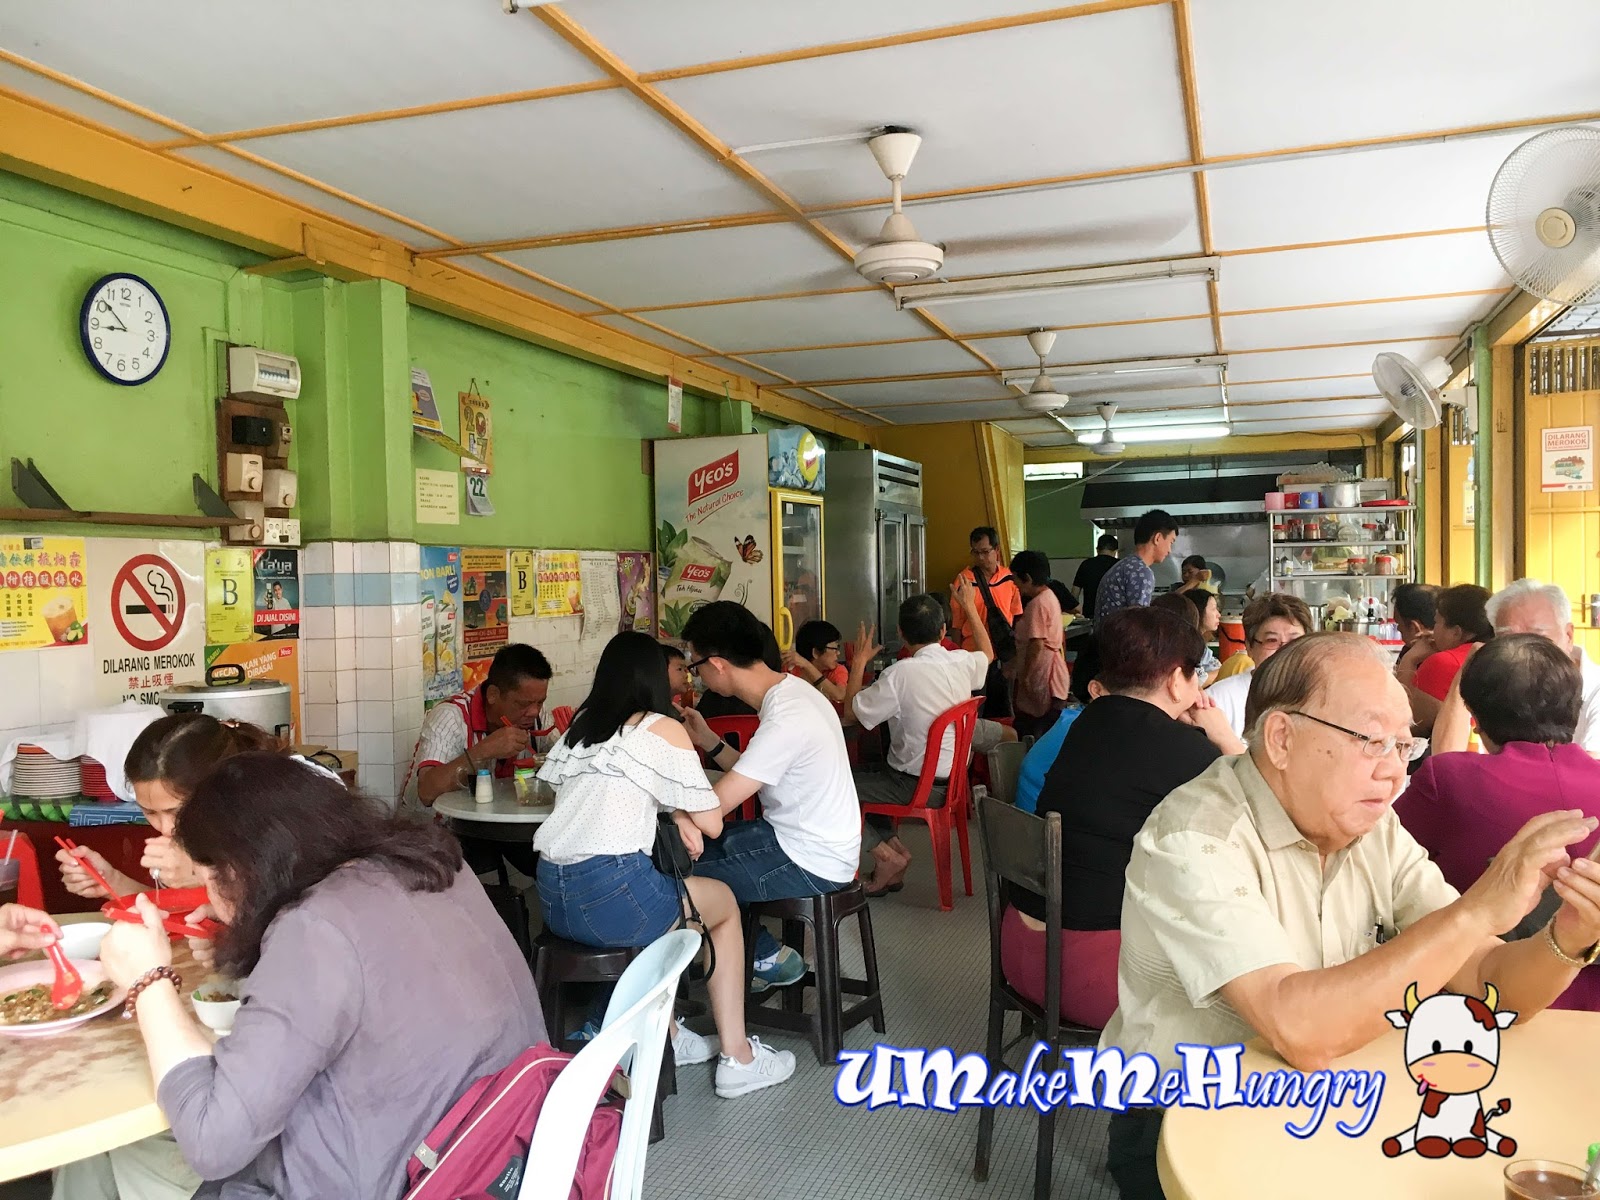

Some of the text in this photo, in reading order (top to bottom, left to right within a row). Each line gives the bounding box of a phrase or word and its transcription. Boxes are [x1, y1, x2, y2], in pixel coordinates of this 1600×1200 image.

[107, 288, 115, 300] 11
[121, 288, 131, 301] 12
[96, 299, 108, 313] 10
[144, 311, 153, 323] 2
[90, 317, 100, 330] 9
[147, 330, 155, 342] 3
[94, 337, 103, 349] 8
[105, 352, 112, 364] 7
[142, 347, 150, 358] 4
[117, 359, 126, 371] 6
[132, 357, 140, 370] 5
[1547, 432, 1586, 441] DILARANG
[469, 477, 485, 498] 22
[686, 490, 744, 522] The Natural Choice
[517, 571, 527, 590] B
[221, 578, 238, 605] B
[257, 612, 296, 622] DI JUAL DISINI
[260, 651, 277, 662] YANG
[103, 652, 196, 674] DILARANG MEROKOK
[128, 672, 174, 689] 禁止吸煙
